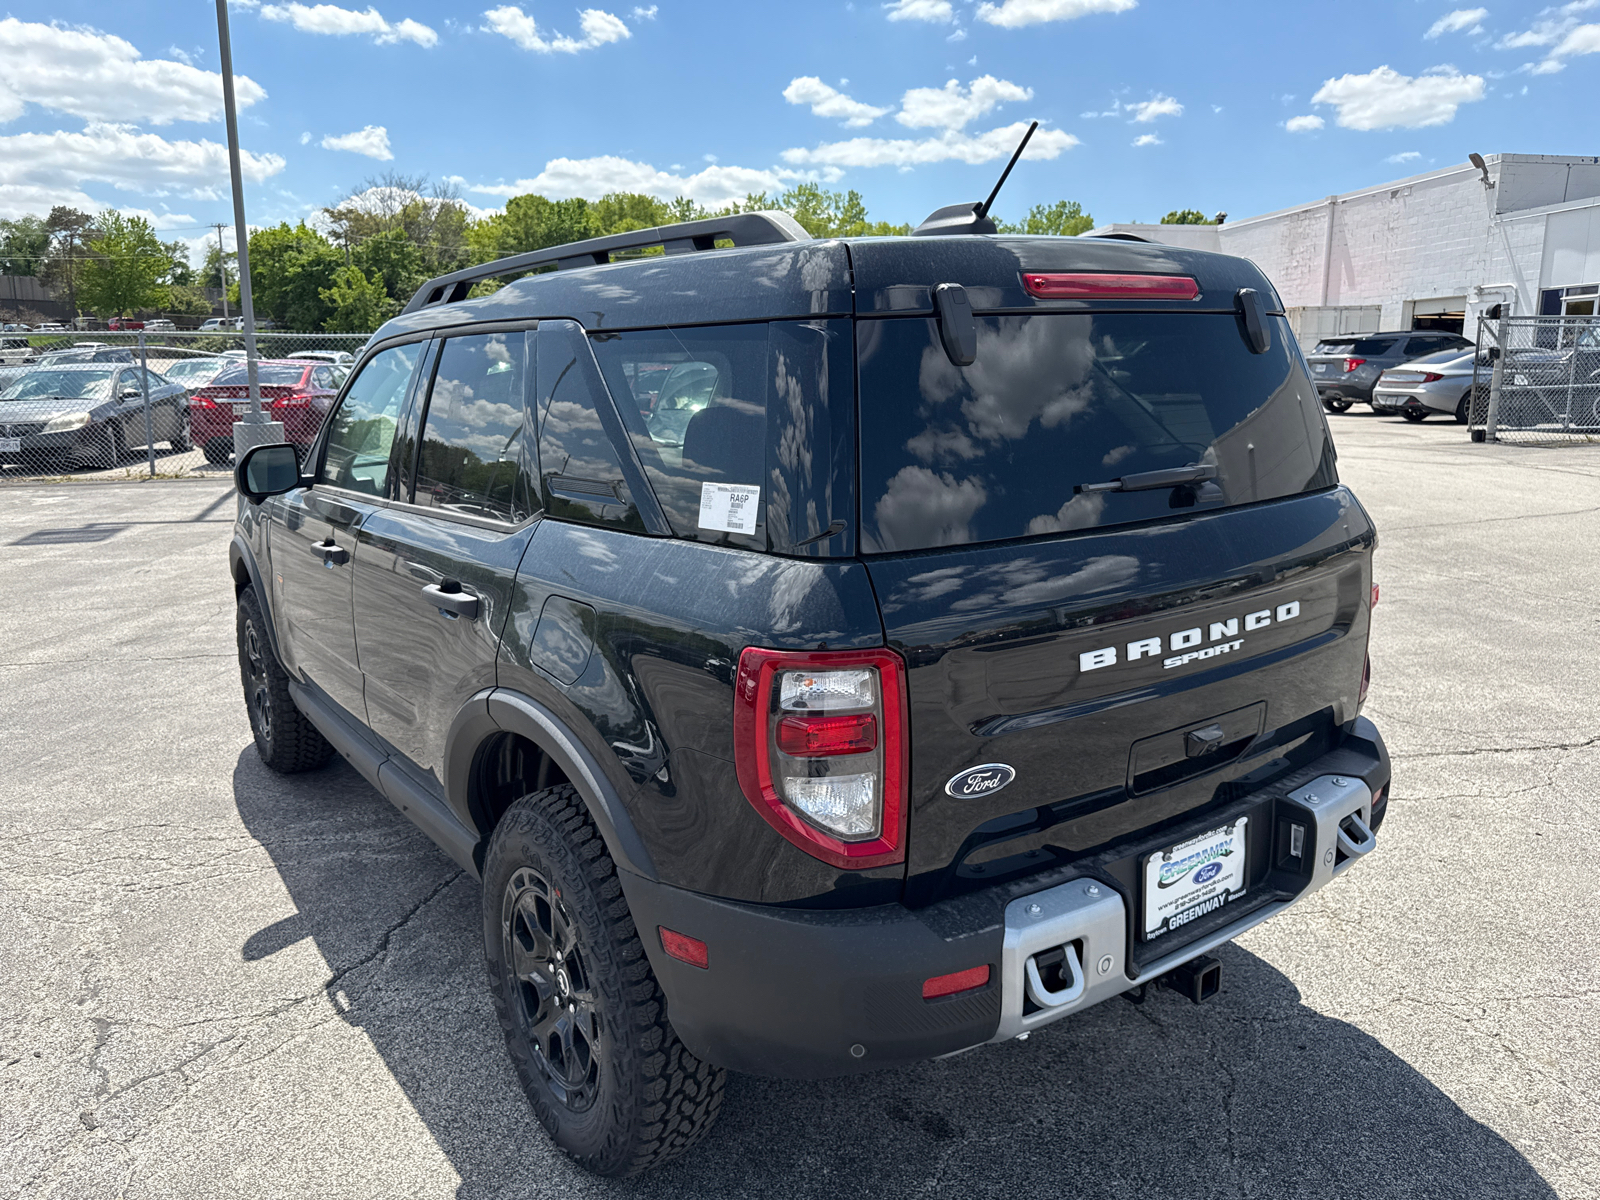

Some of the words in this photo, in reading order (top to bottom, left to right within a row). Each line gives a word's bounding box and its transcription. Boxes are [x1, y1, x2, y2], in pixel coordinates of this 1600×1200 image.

[730, 493, 749, 503] RA6P
[1080, 600, 1300, 673] BRONCO
[1162, 638, 1245, 669] SPORT
[963, 771, 1002, 794] Ford
[1159, 837, 1234, 882] GREENWAY
[1198, 865, 1218, 883] Ford
[1146, 926, 1168, 940] Raytown
[1168, 893, 1227, 931] GREENWAY
[1227, 888, 1247, 902] Missouri
